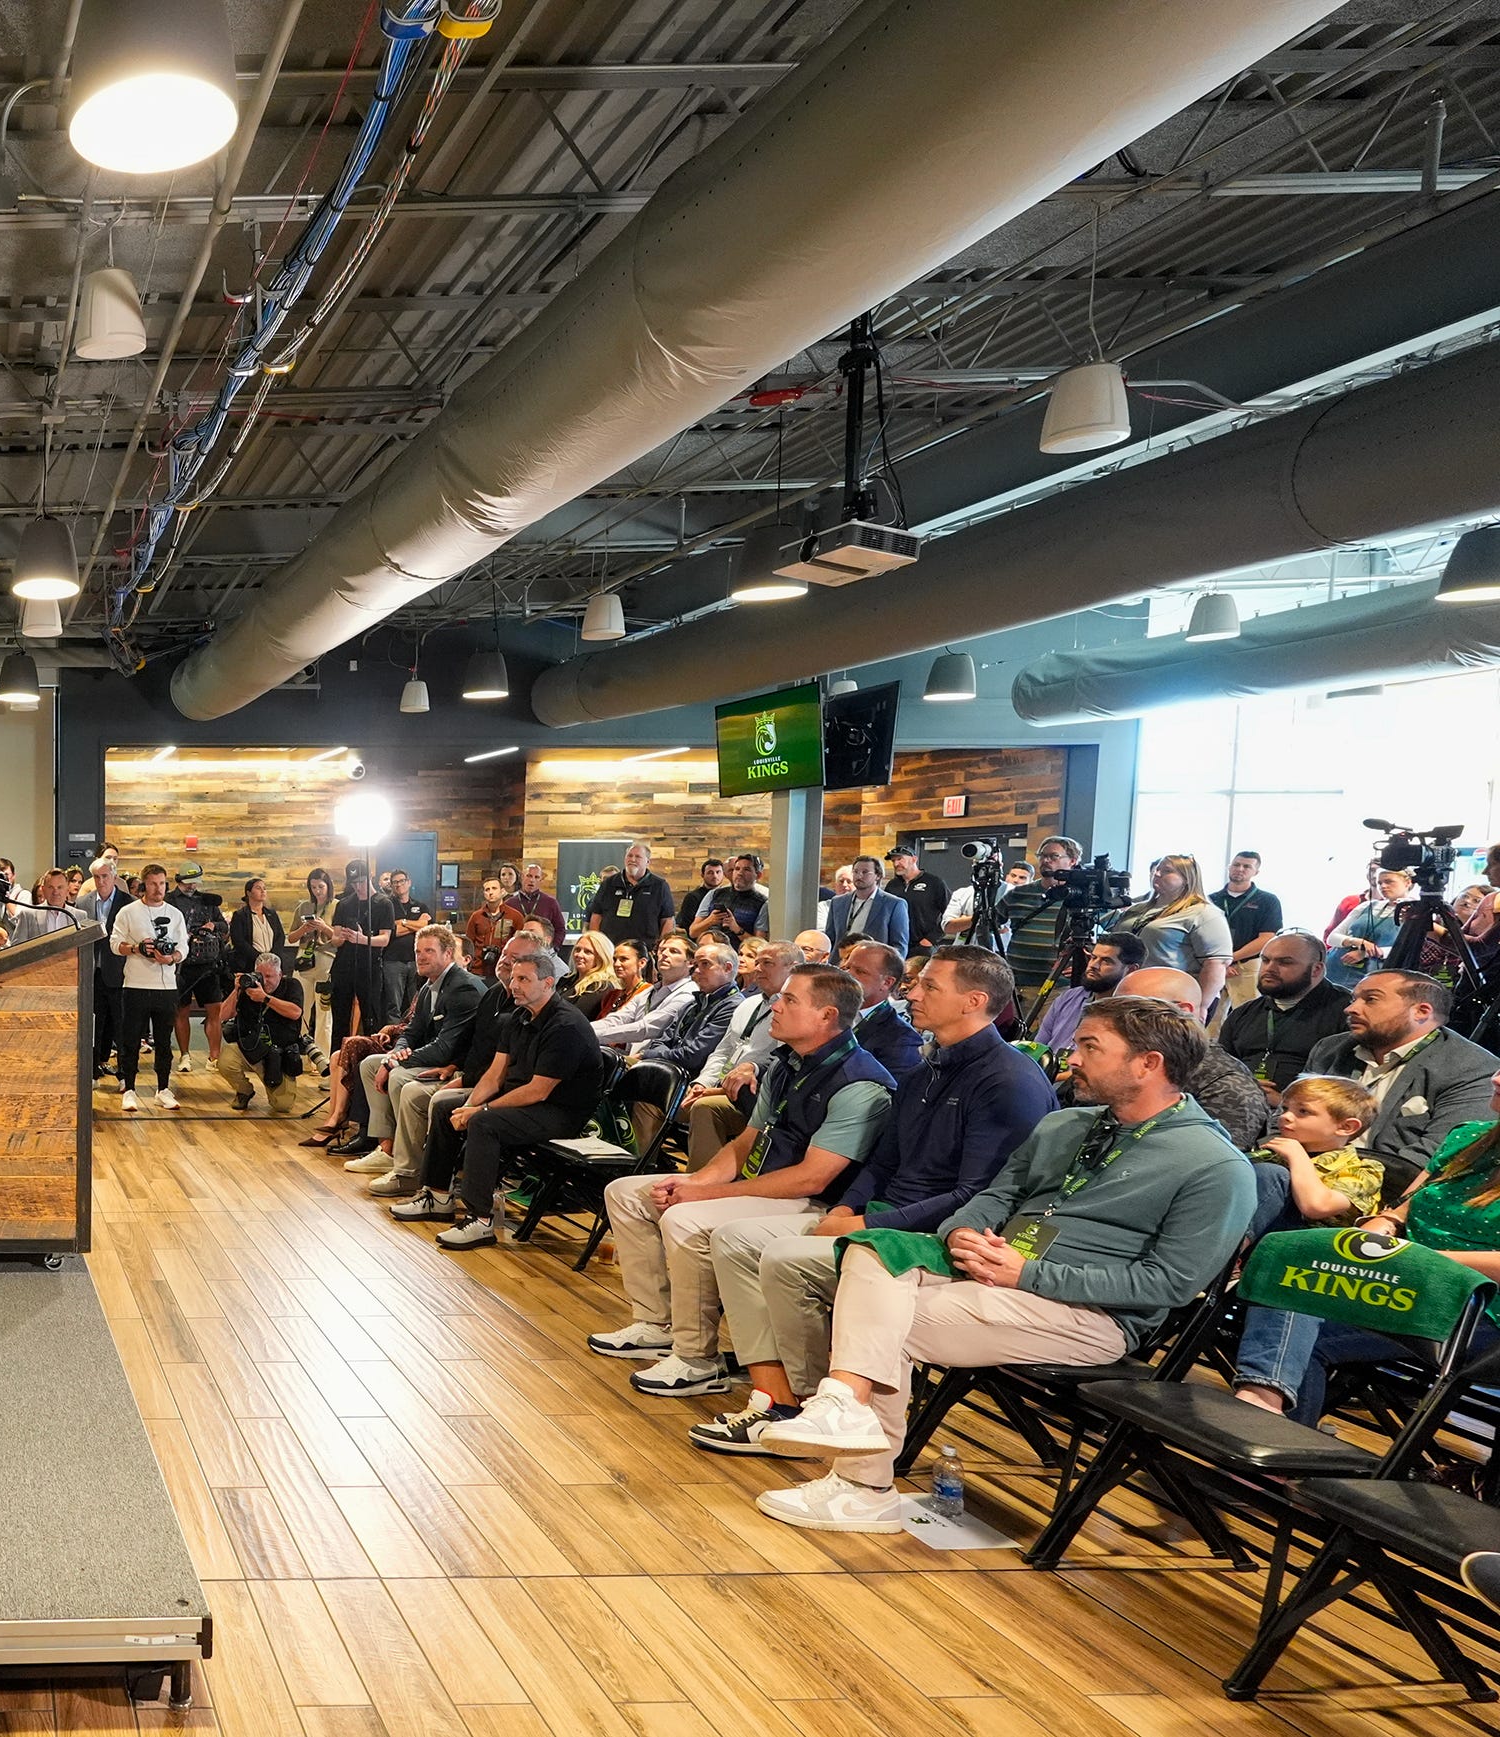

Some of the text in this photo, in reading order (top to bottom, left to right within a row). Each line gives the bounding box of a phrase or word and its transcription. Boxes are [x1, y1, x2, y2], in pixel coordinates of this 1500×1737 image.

[747, 760, 789, 779] KINGS
[947, 798, 962, 815] EXIT
[1311, 1260, 1401, 1285] LOUISVILLE
[1278, 1265, 1419, 1313] KINGS
